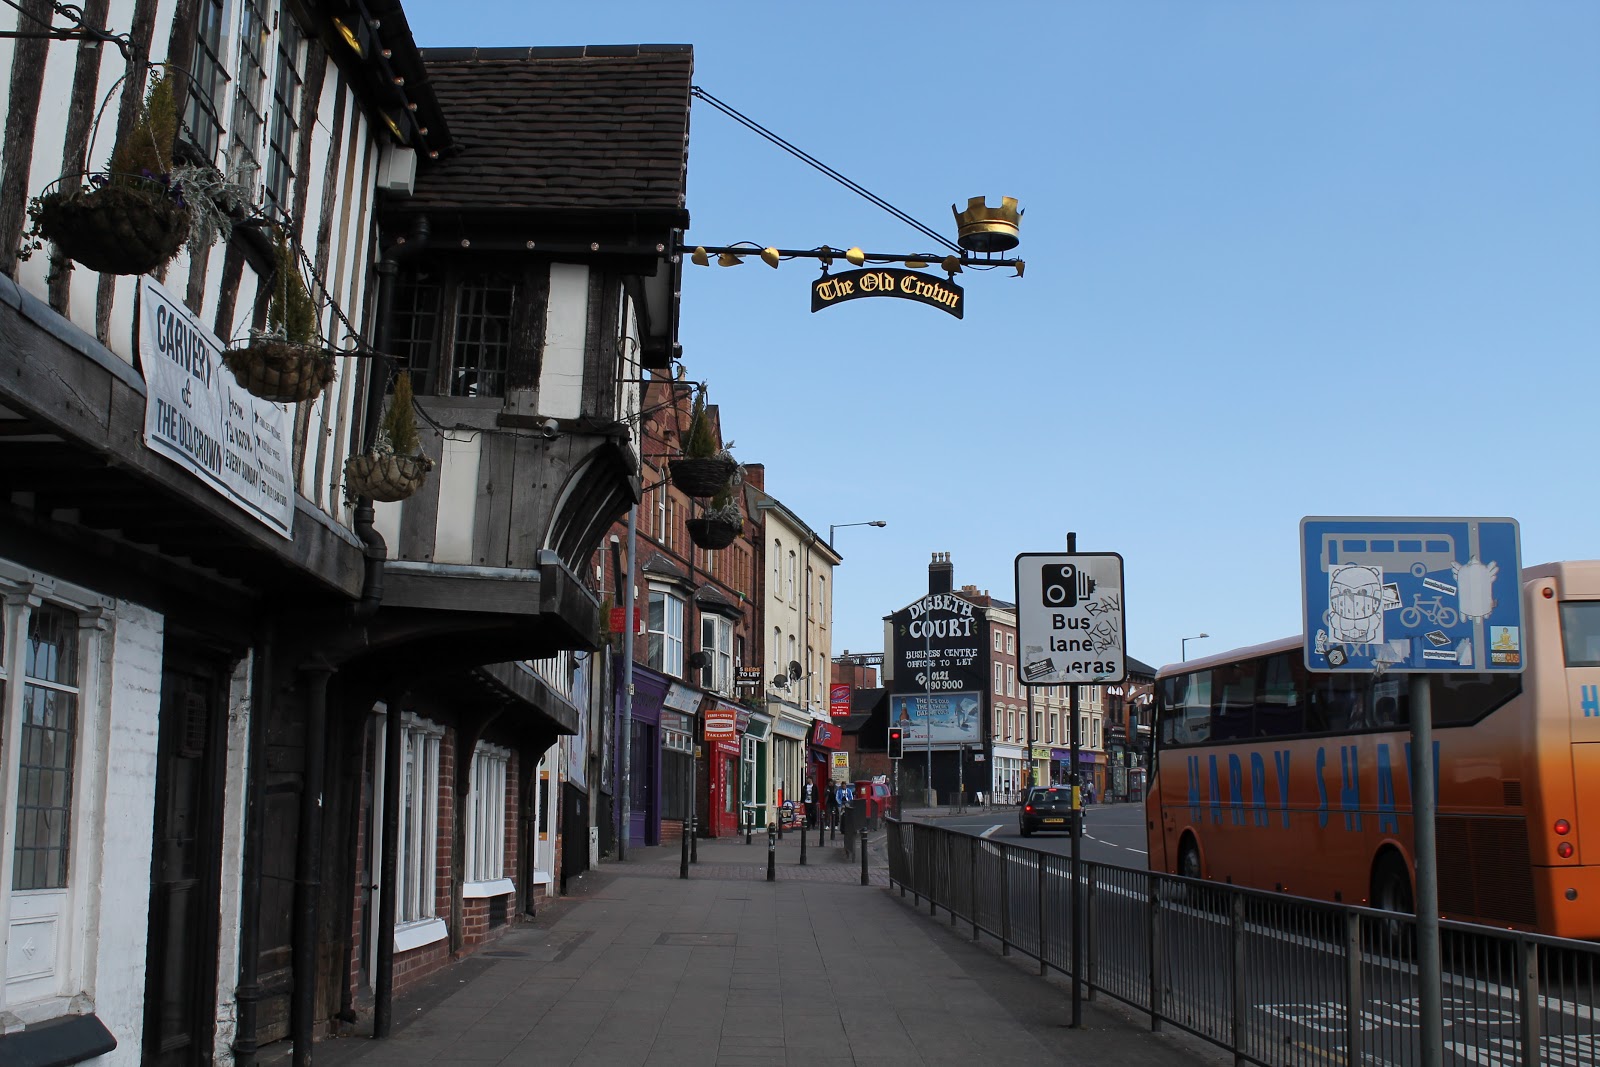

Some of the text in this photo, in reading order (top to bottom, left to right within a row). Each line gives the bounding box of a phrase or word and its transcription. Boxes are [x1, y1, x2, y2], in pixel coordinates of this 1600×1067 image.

[816, 272, 960, 308] The Old Crown
[157, 304, 211, 390] CARVERY
[157, 398, 177, 441] THE
[179, 413, 194, 453] OLD
[194, 426, 222, 475] CROWN
[225, 448, 241, 475] EVERY
[242, 461, 258, 488] SUNDAY
[908, 595, 973, 619] DIGBETH
[909, 617, 975, 638] COURT
[1052, 614, 1091, 630] Bus
[906, 648, 978, 659] BUSINESS CENTRE
[1050, 636, 1093, 652] lane
[956, 658, 973, 666] LET
[931, 671, 949, 680] 0121
[942, 680, 963, 689] 9000
[1188, 750, 1291, 829] HARRY
